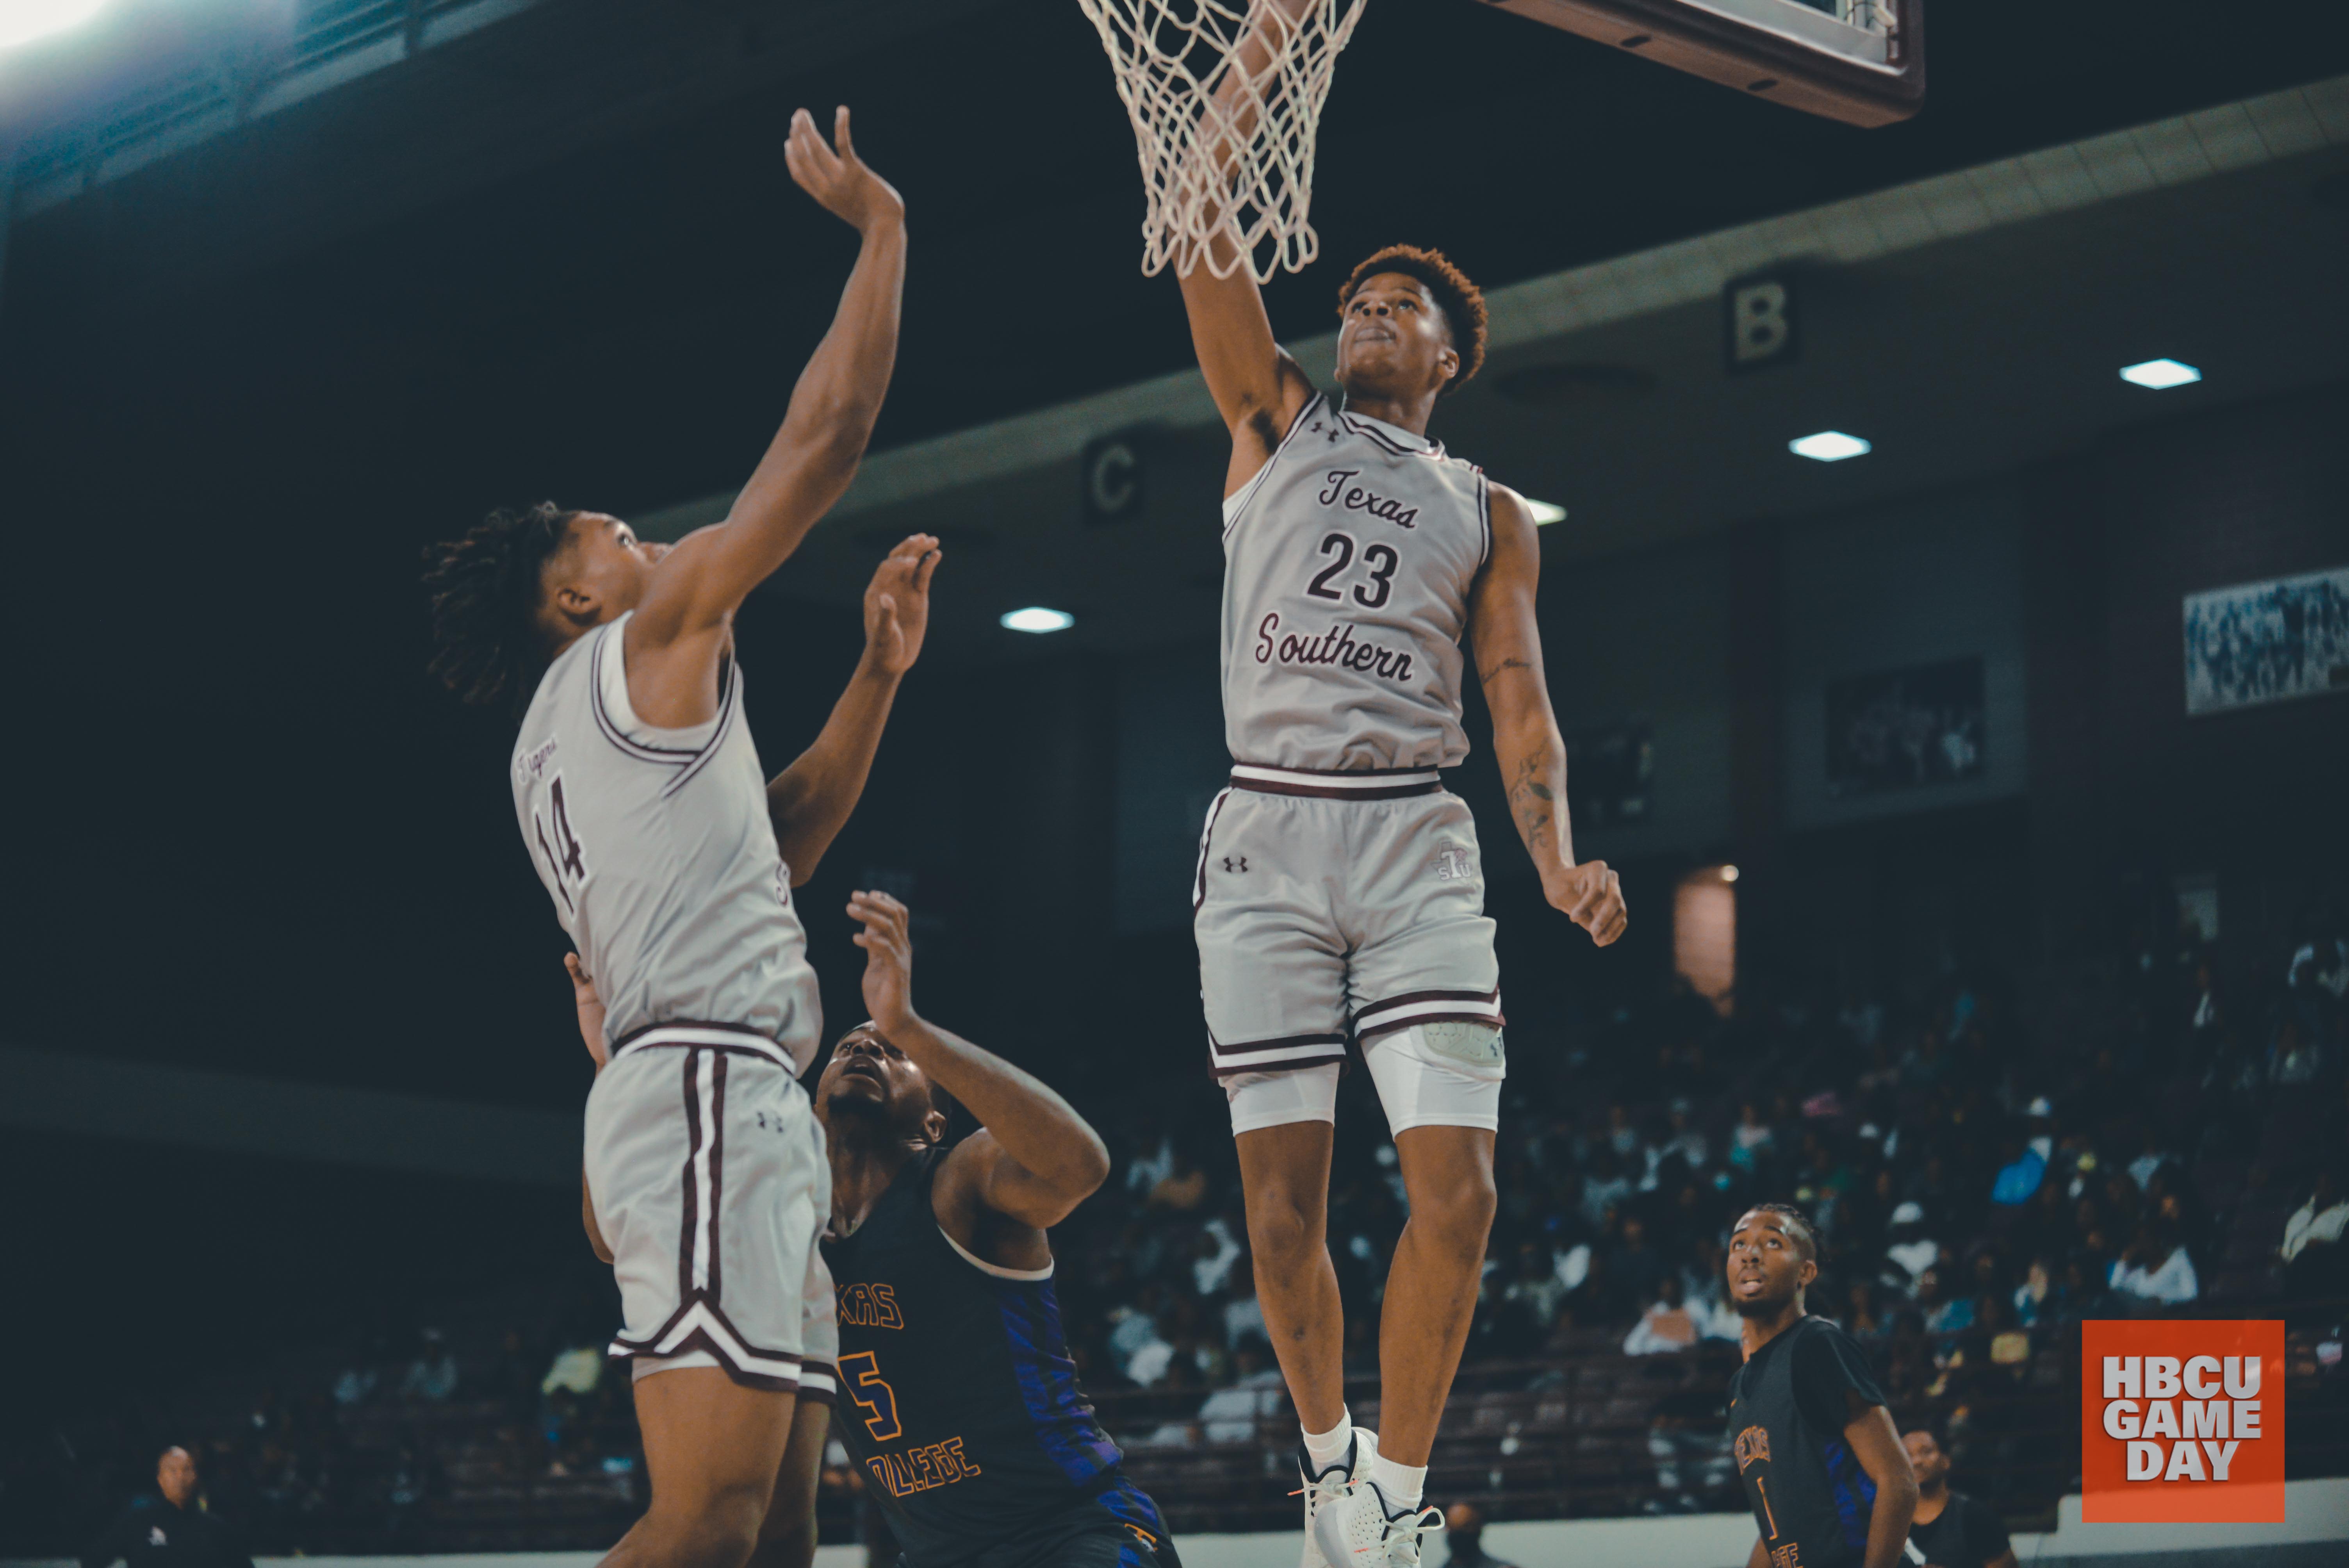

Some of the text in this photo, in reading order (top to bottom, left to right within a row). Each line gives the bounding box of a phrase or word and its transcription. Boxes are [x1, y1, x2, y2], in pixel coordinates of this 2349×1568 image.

[1736, 284, 1787, 360] B
[1094, 445, 1134, 512] C
[1318, 470, 1419, 529] Texas
[1307, 533, 1399, 609] 23
[1255, 613, 1412, 682] Southern
[535, 775, 586, 915] 14
[834, 1283, 904, 1330] XAS
[837, 1350, 902, 1441] 5
[865, 1436, 982, 1497] OLLEGE
